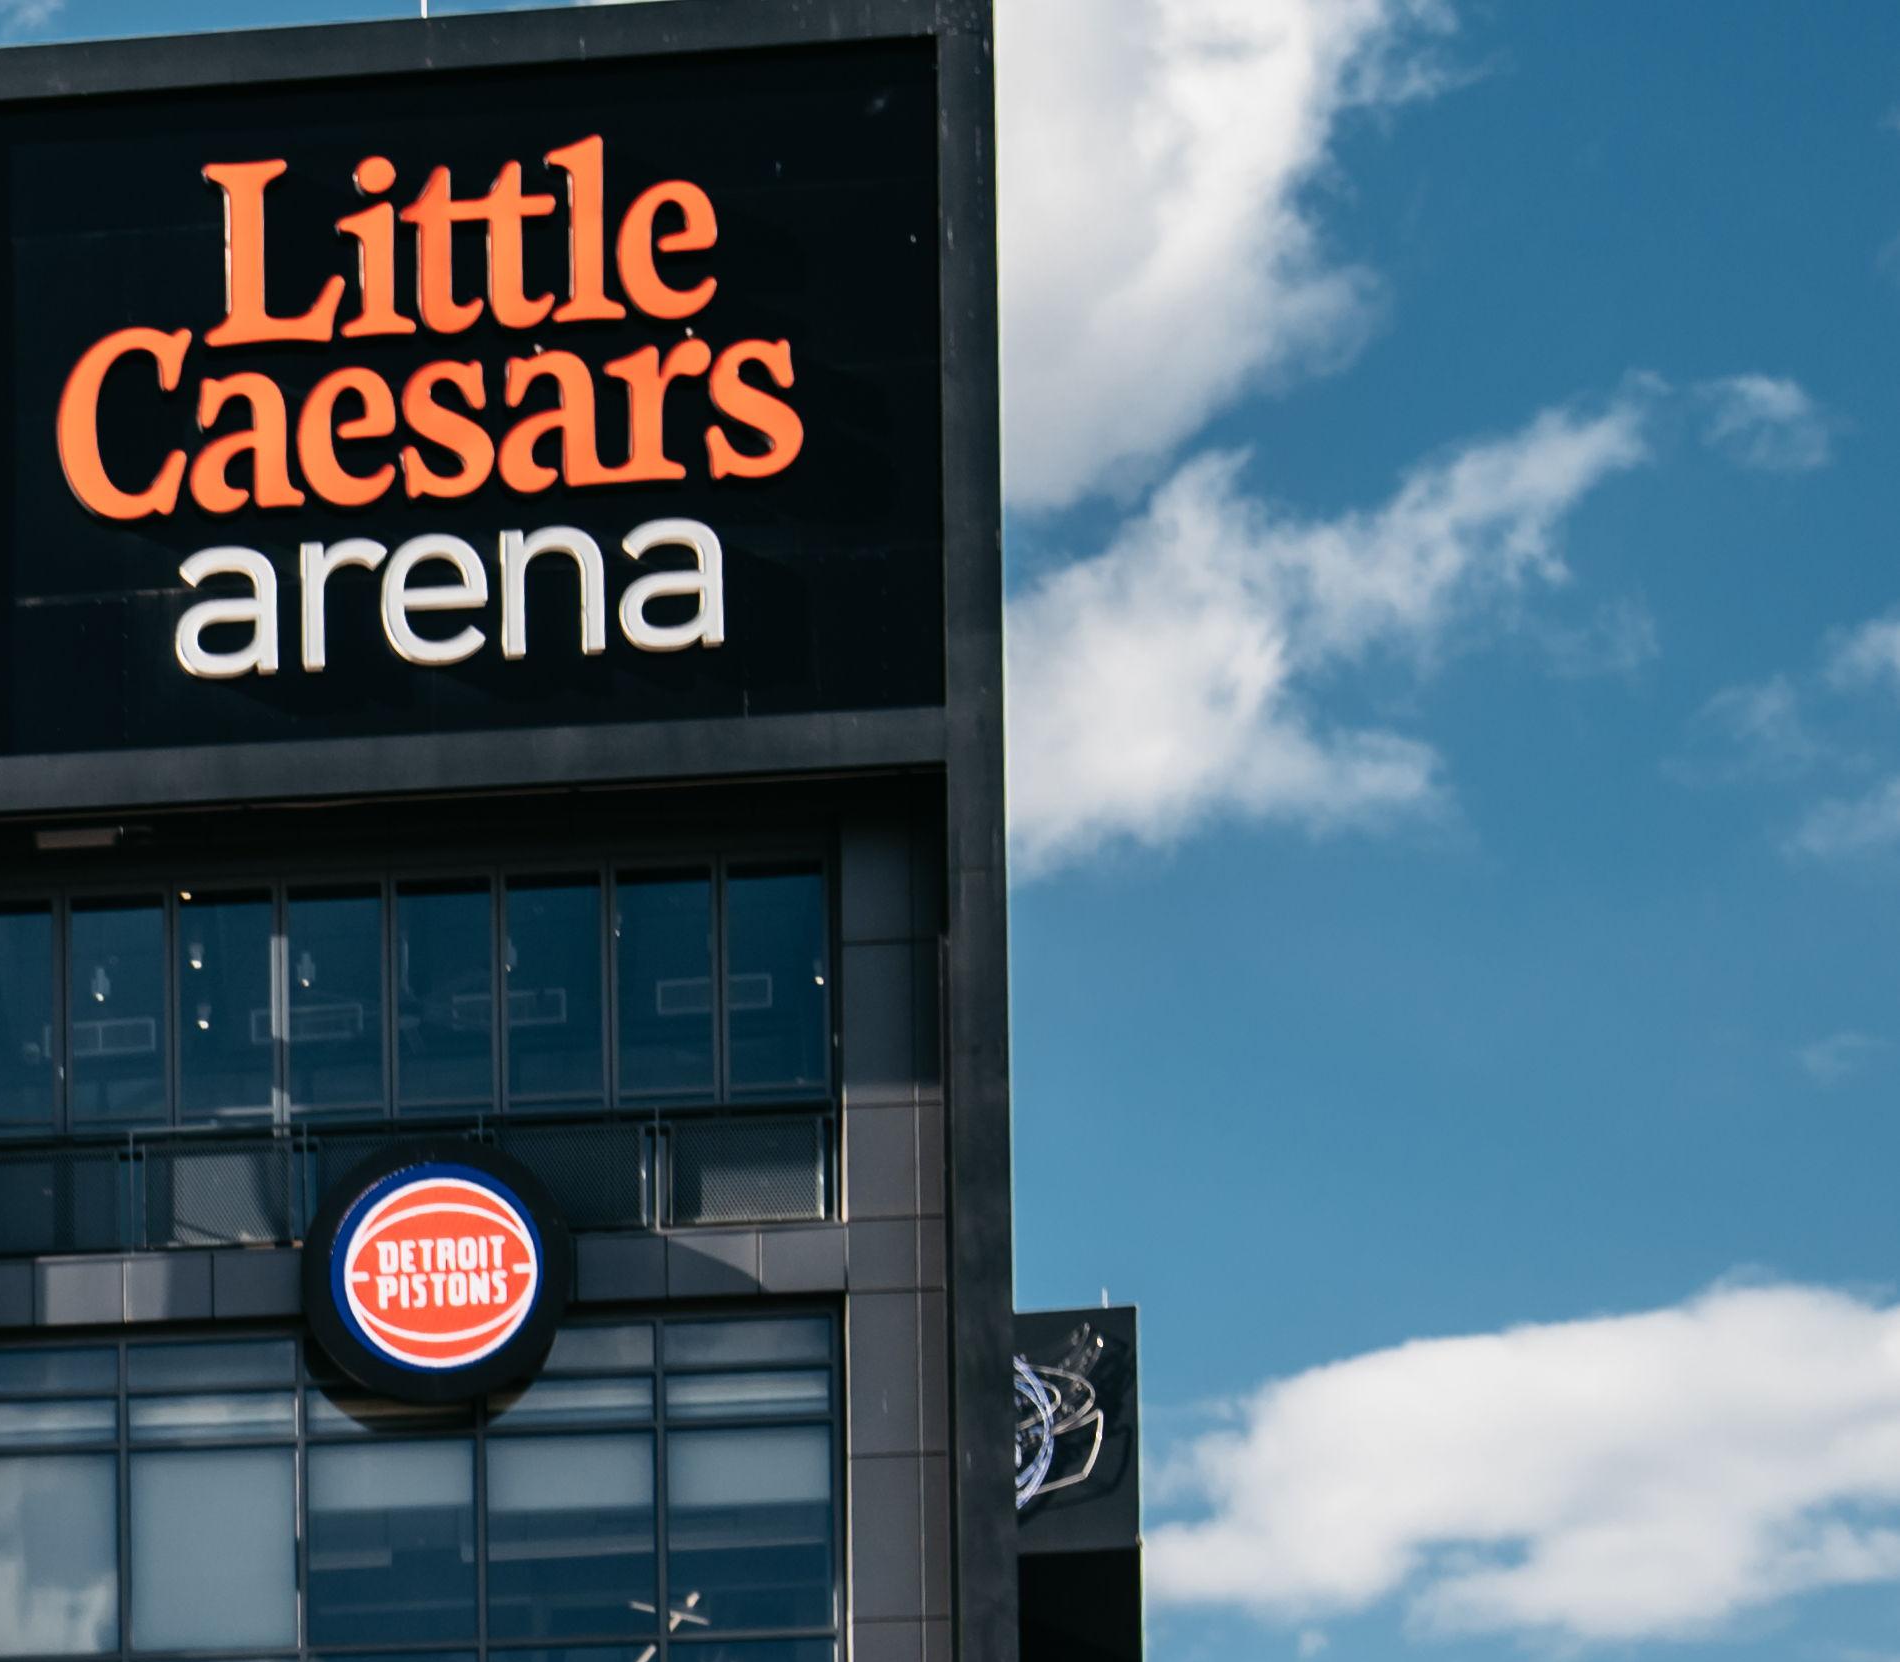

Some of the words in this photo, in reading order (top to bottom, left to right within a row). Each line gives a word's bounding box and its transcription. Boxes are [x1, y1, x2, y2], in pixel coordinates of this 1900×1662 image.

[202, 133, 719, 347] Little
[57, 326, 805, 520] Caesars
[174, 518, 726, 676] arena
[375, 1235, 506, 1275] DETROIT
[375, 1269, 508, 1310] PISTONS
